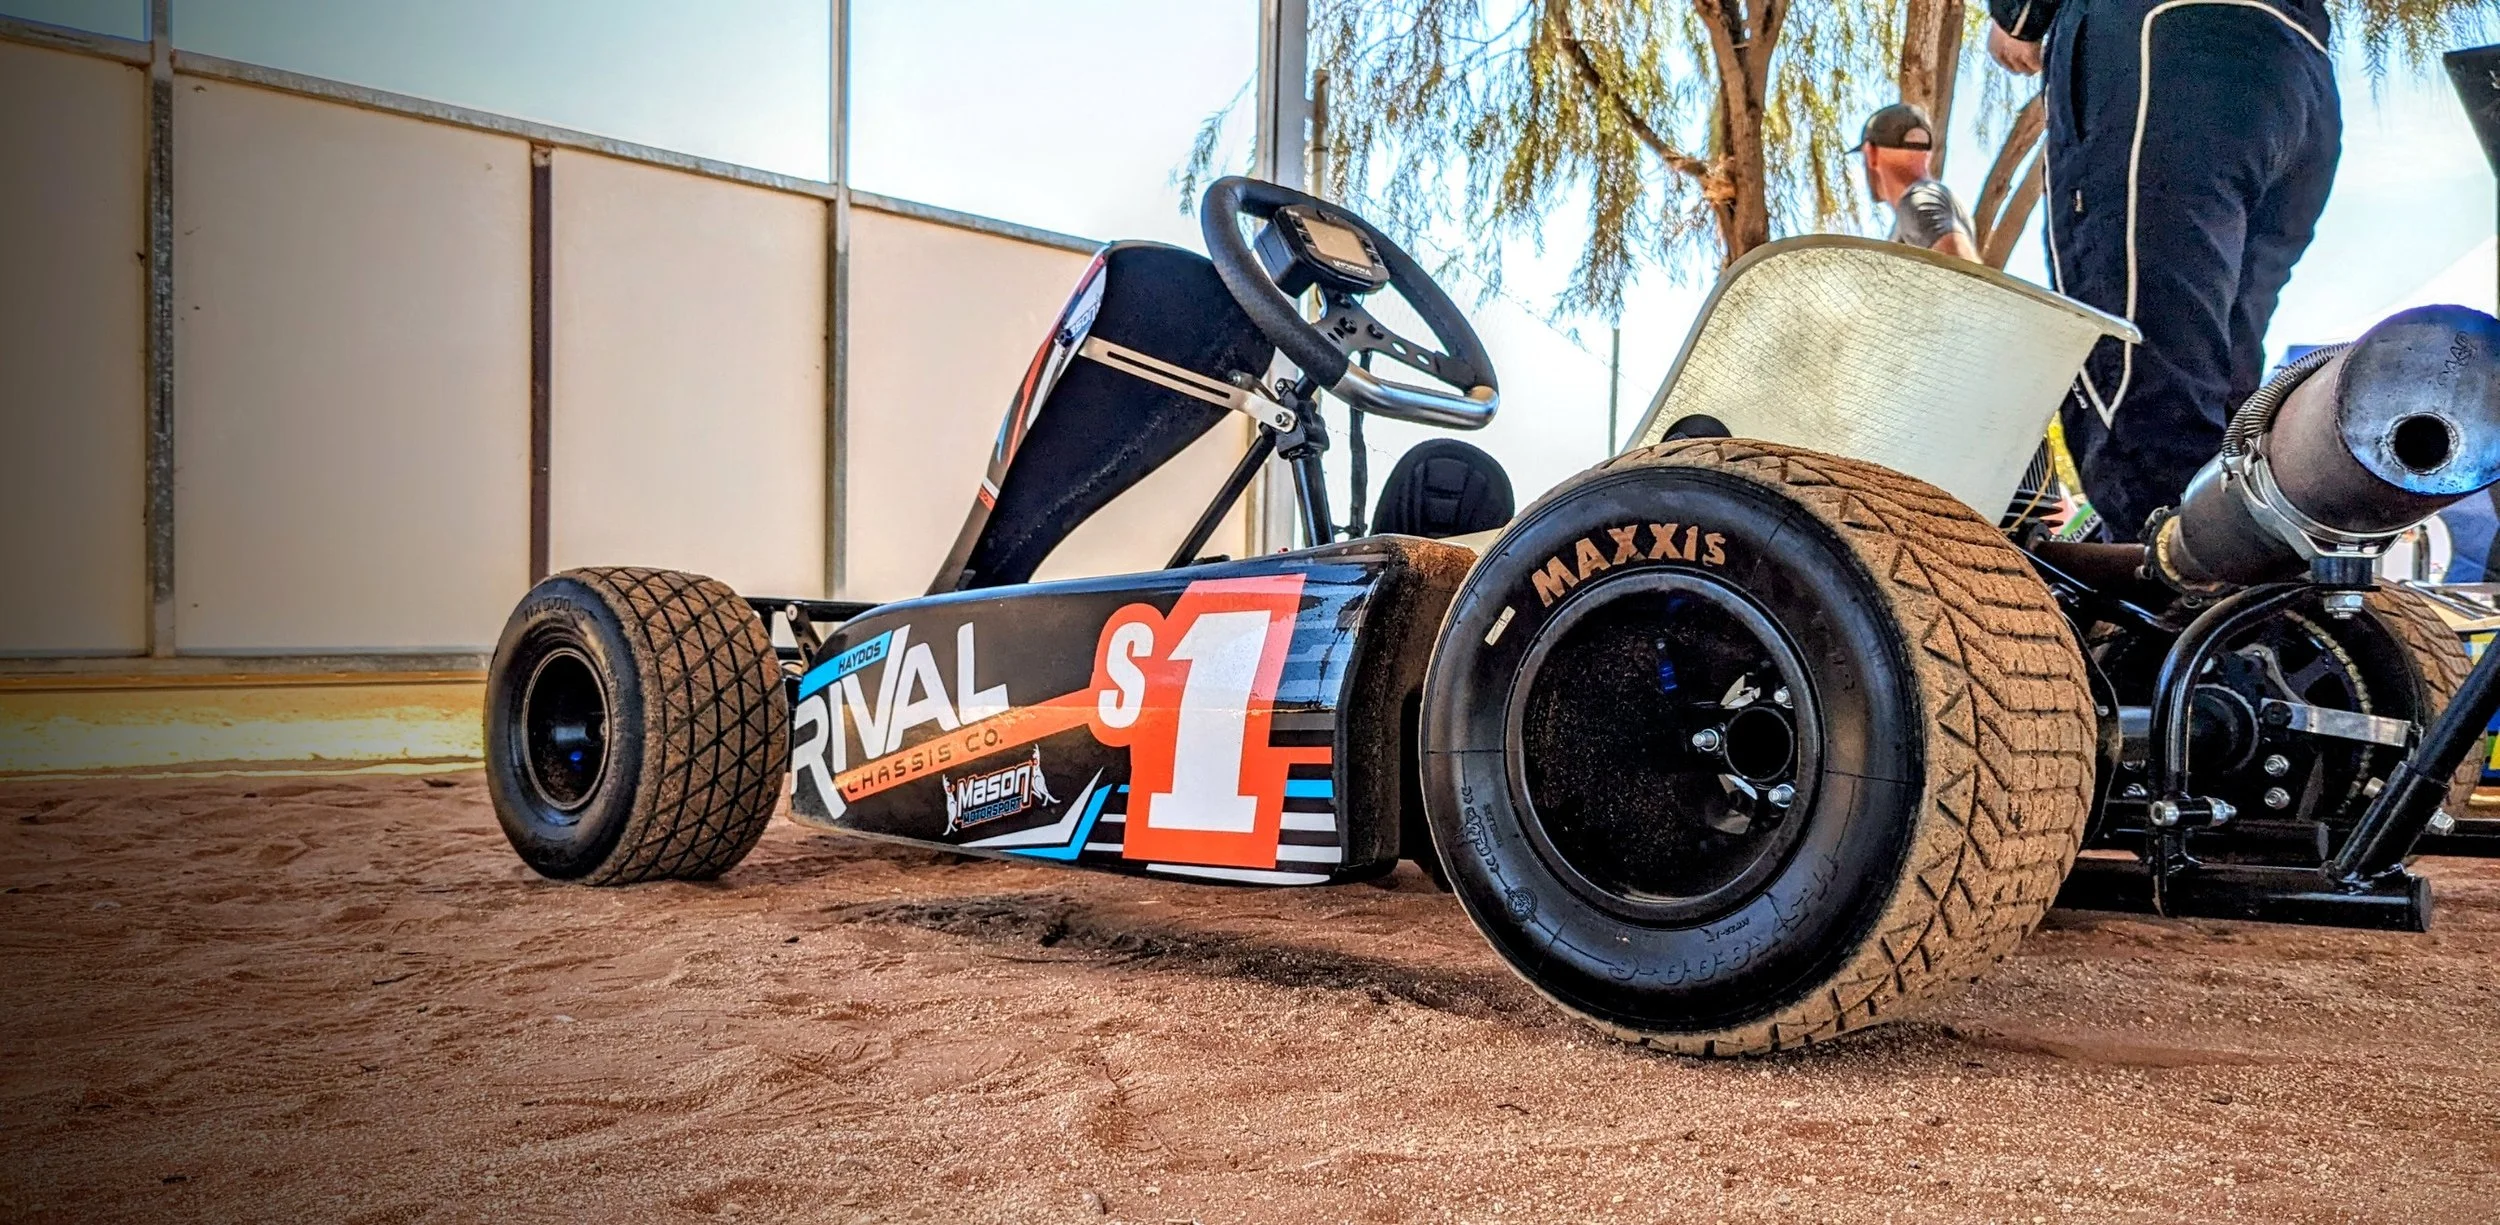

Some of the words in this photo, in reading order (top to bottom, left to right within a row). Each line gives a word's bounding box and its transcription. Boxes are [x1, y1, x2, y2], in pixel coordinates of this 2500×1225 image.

[838, 641, 881, 675] HAYDOS
[790, 621, 1010, 820] RIVAL
[846, 743, 952, 794] CHASSIS
[965, 728, 1003, 753] CO.
[962, 797, 1022, 824] MOTORSPORT
